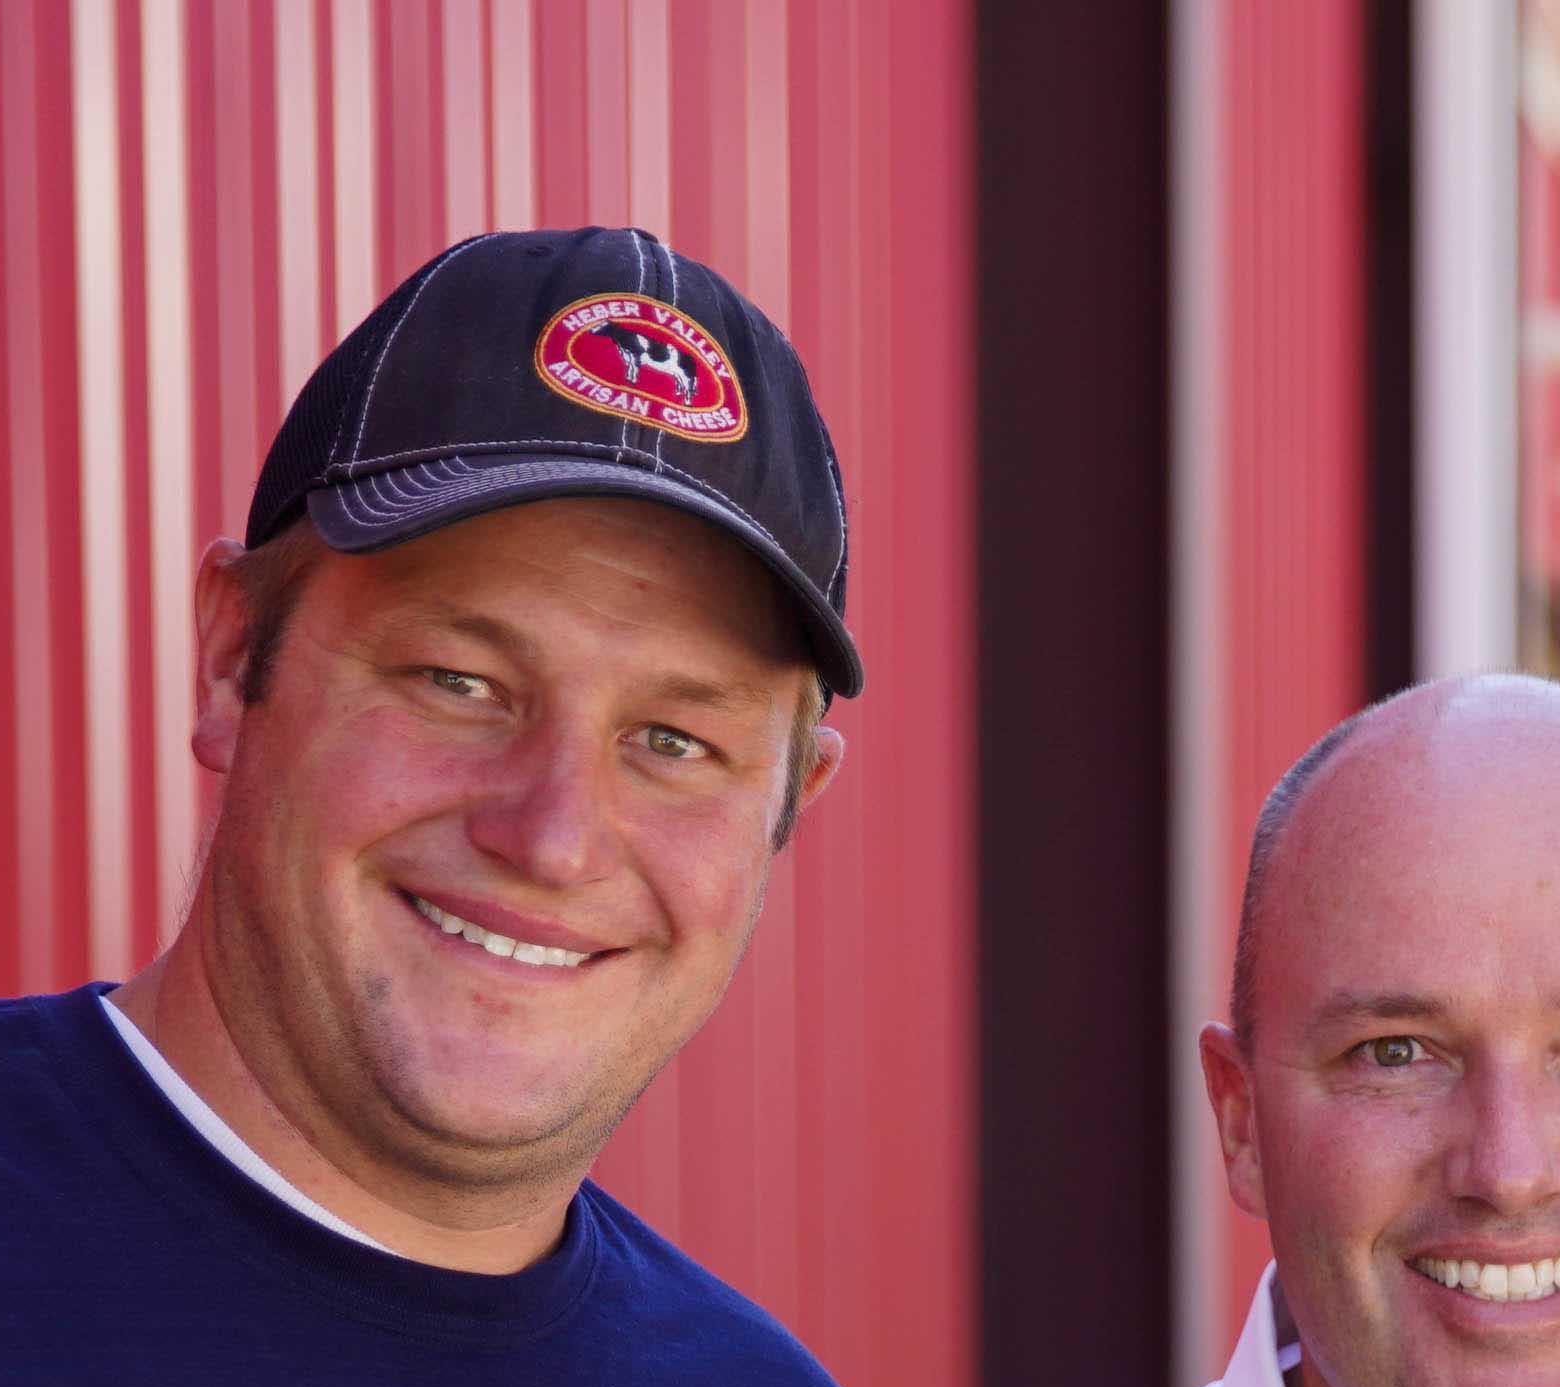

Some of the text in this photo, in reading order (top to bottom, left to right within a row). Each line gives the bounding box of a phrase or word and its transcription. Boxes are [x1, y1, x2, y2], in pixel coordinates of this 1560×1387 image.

[562, 301, 730, 378] HEBER VALLEY
[549, 360, 736, 429] ARTISAN CHEESE
